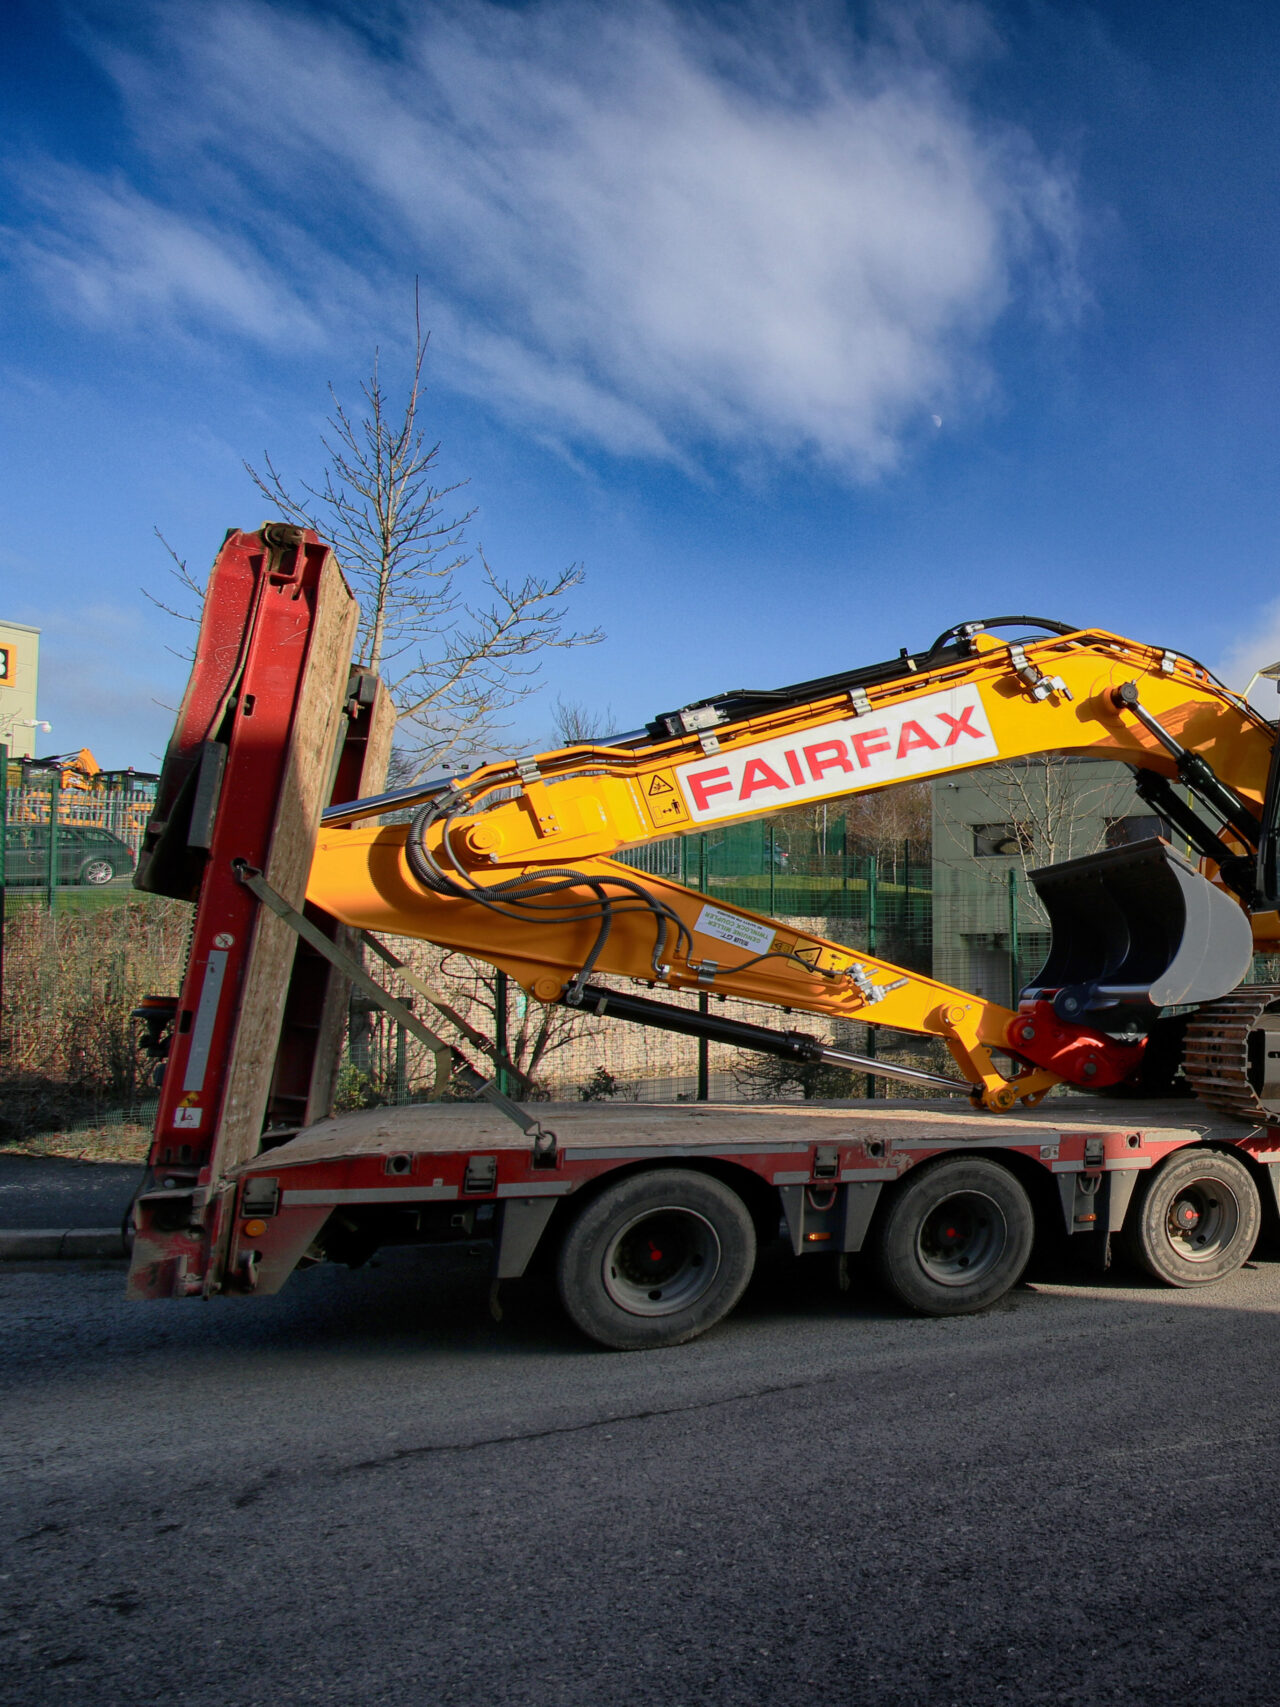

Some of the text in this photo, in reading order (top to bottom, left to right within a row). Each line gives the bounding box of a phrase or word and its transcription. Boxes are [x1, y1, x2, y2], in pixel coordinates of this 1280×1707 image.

[686, 705, 987, 811] FAIRFAX
[705, 912, 768, 939] TWINLOCK COUPLER
[708, 920, 760, 943] GENUINE MILLER
